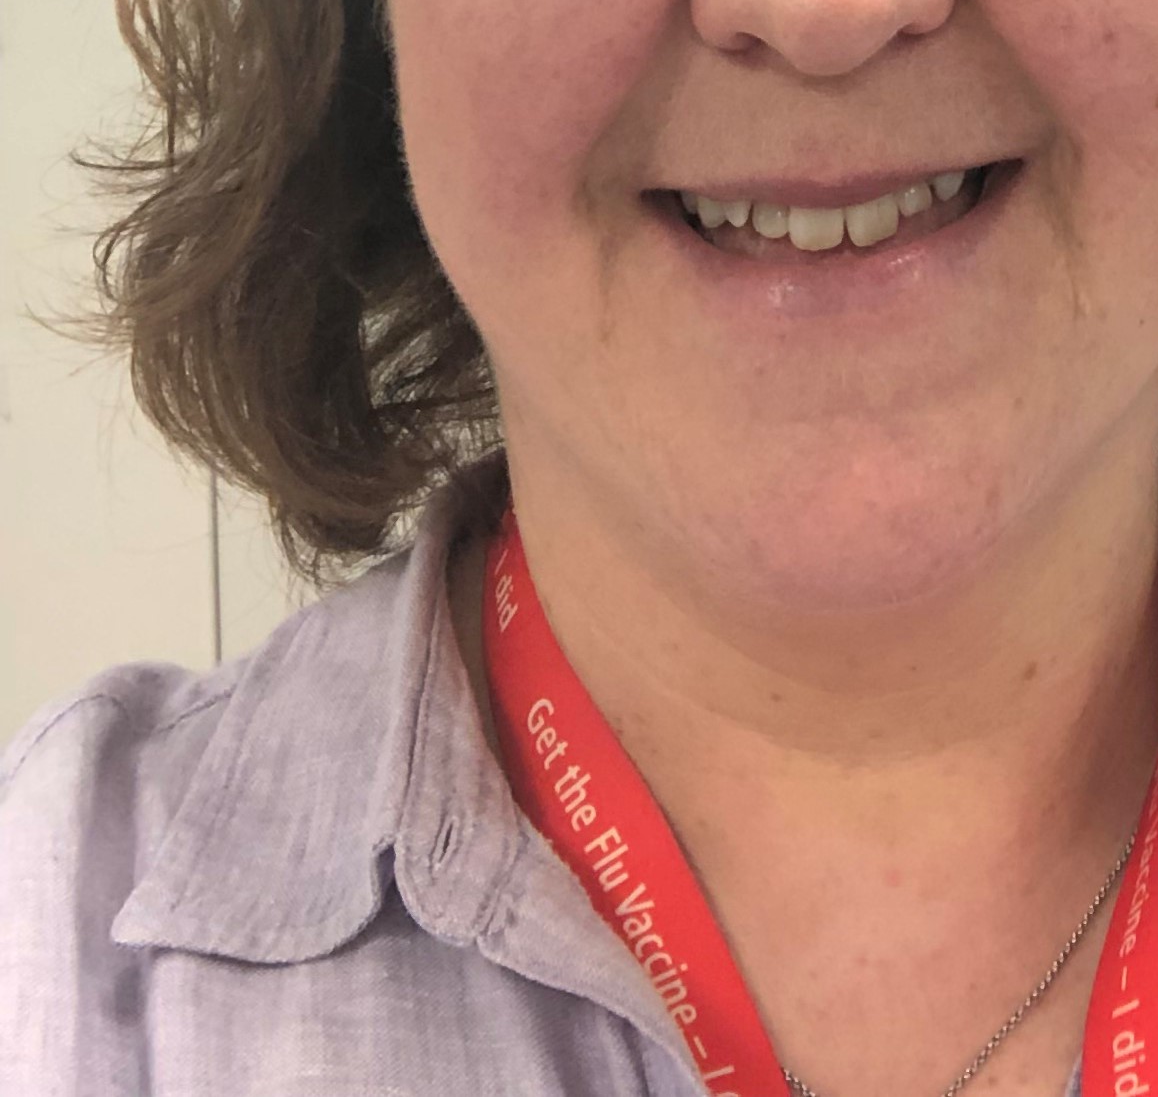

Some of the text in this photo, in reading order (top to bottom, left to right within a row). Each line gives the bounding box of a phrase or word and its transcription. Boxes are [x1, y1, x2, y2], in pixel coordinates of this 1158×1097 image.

[495, 574, 519, 633] did
[526, 697, 568, 771] Get
[554, 764, 598, 833] the
[584, 826, 629, 893] Flu
[613, 883, 698, 1026] Vaccine
[1112, 1030, 1150, 1097] did
